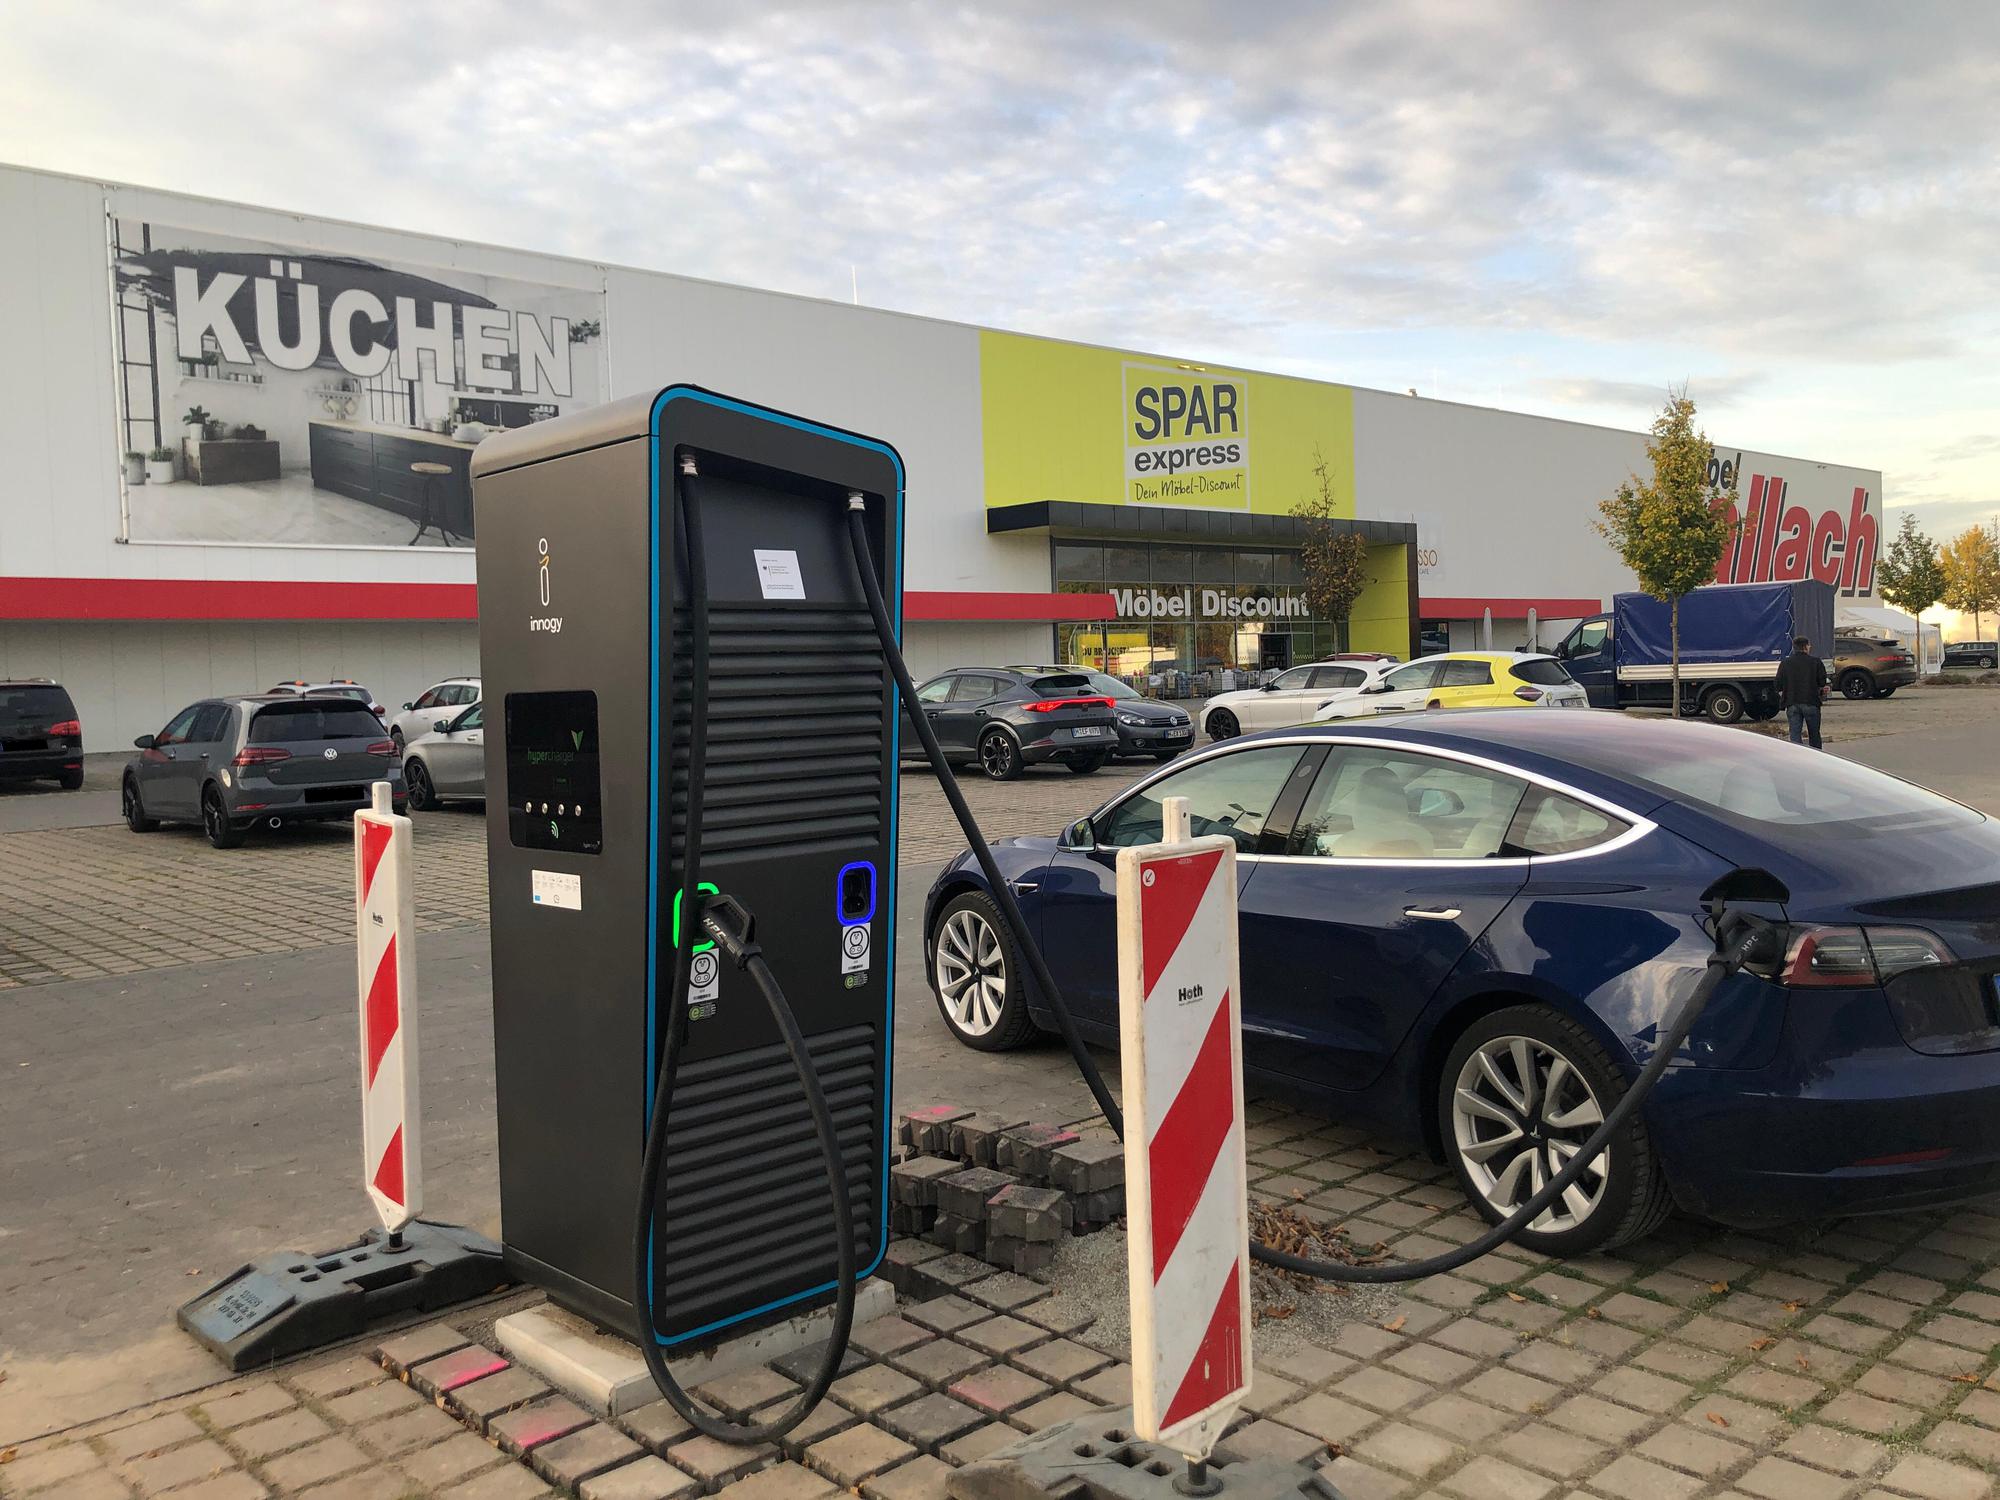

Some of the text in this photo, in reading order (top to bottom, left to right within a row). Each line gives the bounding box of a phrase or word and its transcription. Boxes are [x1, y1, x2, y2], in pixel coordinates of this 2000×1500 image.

[174, 258, 573, 398] KÜCHEN
[1134, 383, 1239, 441] SPAR
[1134, 443, 1241, 475] express
[1707, 448, 1742, 489] bel
[1135, 473, 1243, 501] Dein Möbel-Discount
[1109, 588, 1310, 617] Möbel Discount
[530, 615, 563, 633] innogy
[527, 747, 575, 765] hypercharger
[1741, 935, 1759, 952] HPC
[1178, 984, 1203, 1002] Hoth
